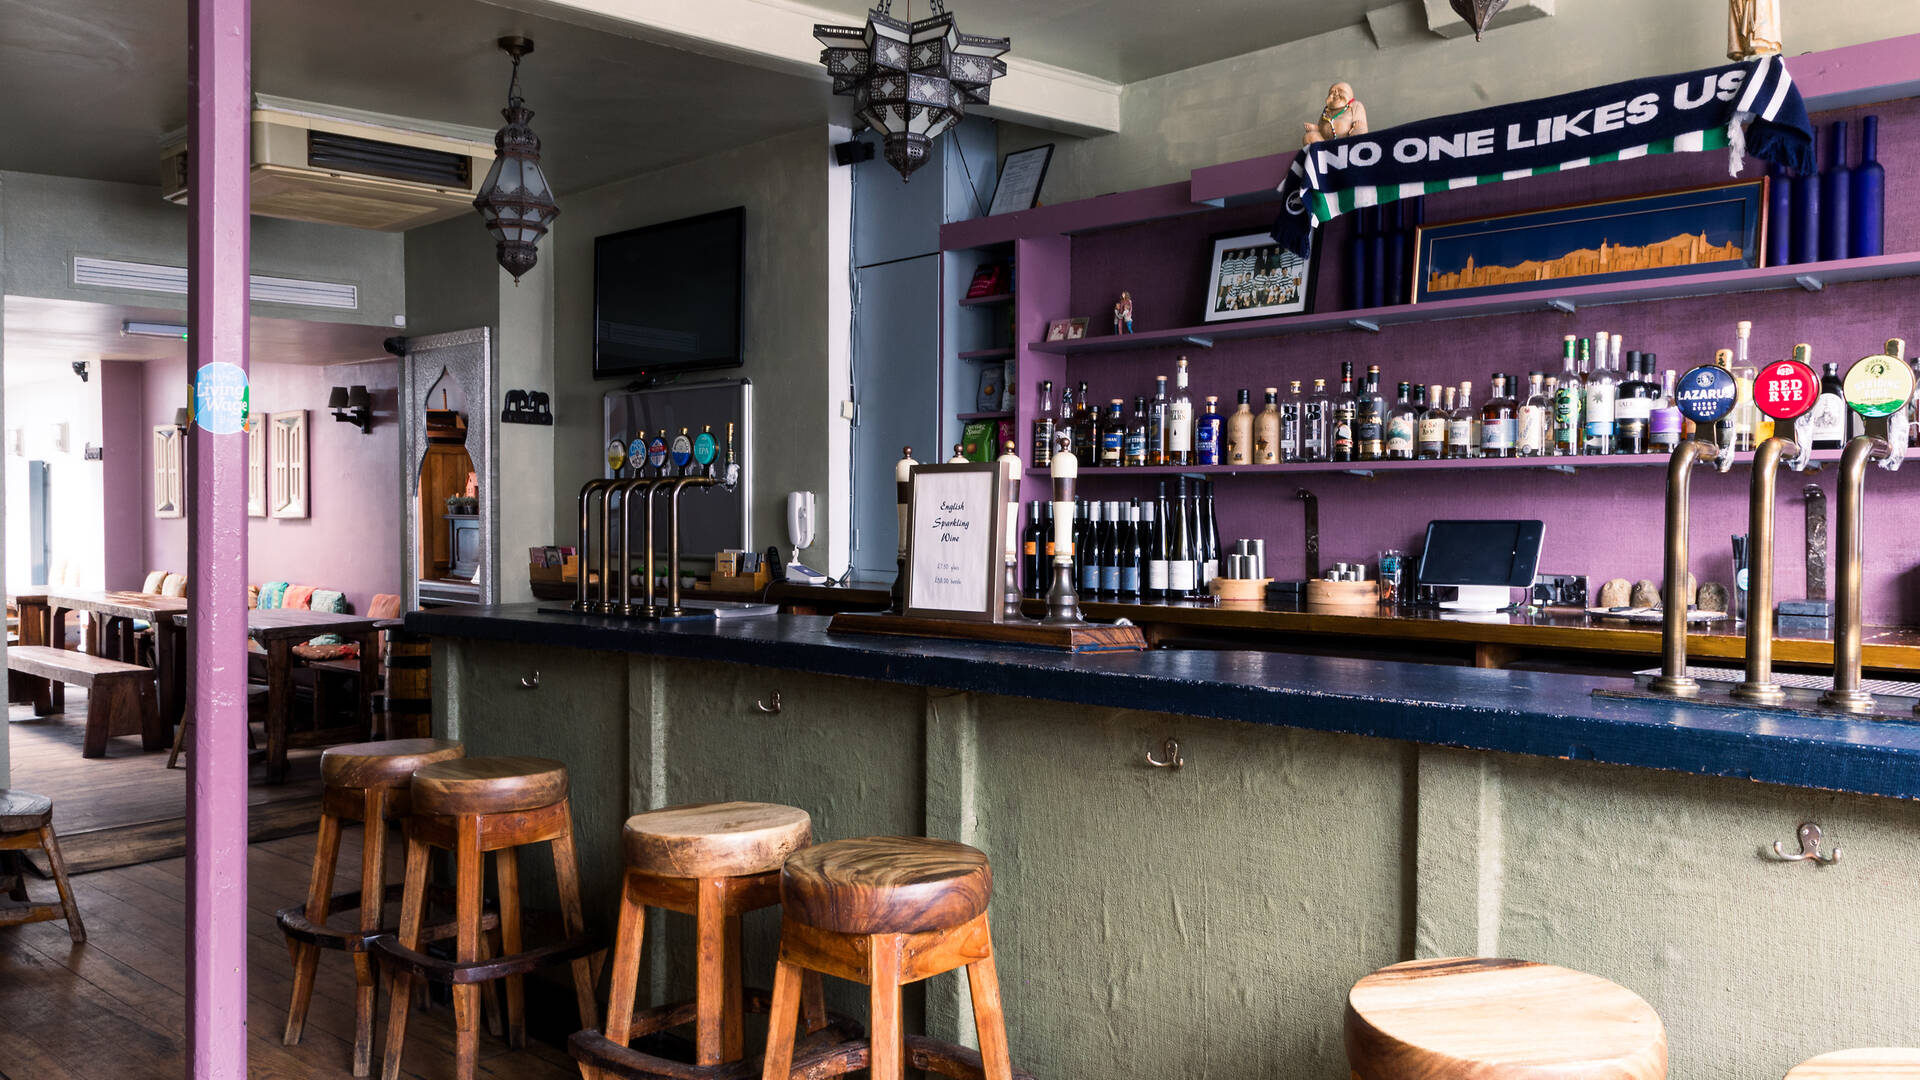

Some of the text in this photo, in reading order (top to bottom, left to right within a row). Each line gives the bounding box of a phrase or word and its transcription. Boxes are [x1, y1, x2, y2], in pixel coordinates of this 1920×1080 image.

[1317, 70, 1747, 174] NO ONE LIKES US
[197, 382, 245, 400] Living
[1768, 379, 1803, 391] RED
[1768, 390, 1803, 402] RYE
[205, 397, 248, 415] Wage
[940, 501, 965, 513] English
[932, 517, 970, 530] Sparkling
[940, 533, 960, 542] Wine
